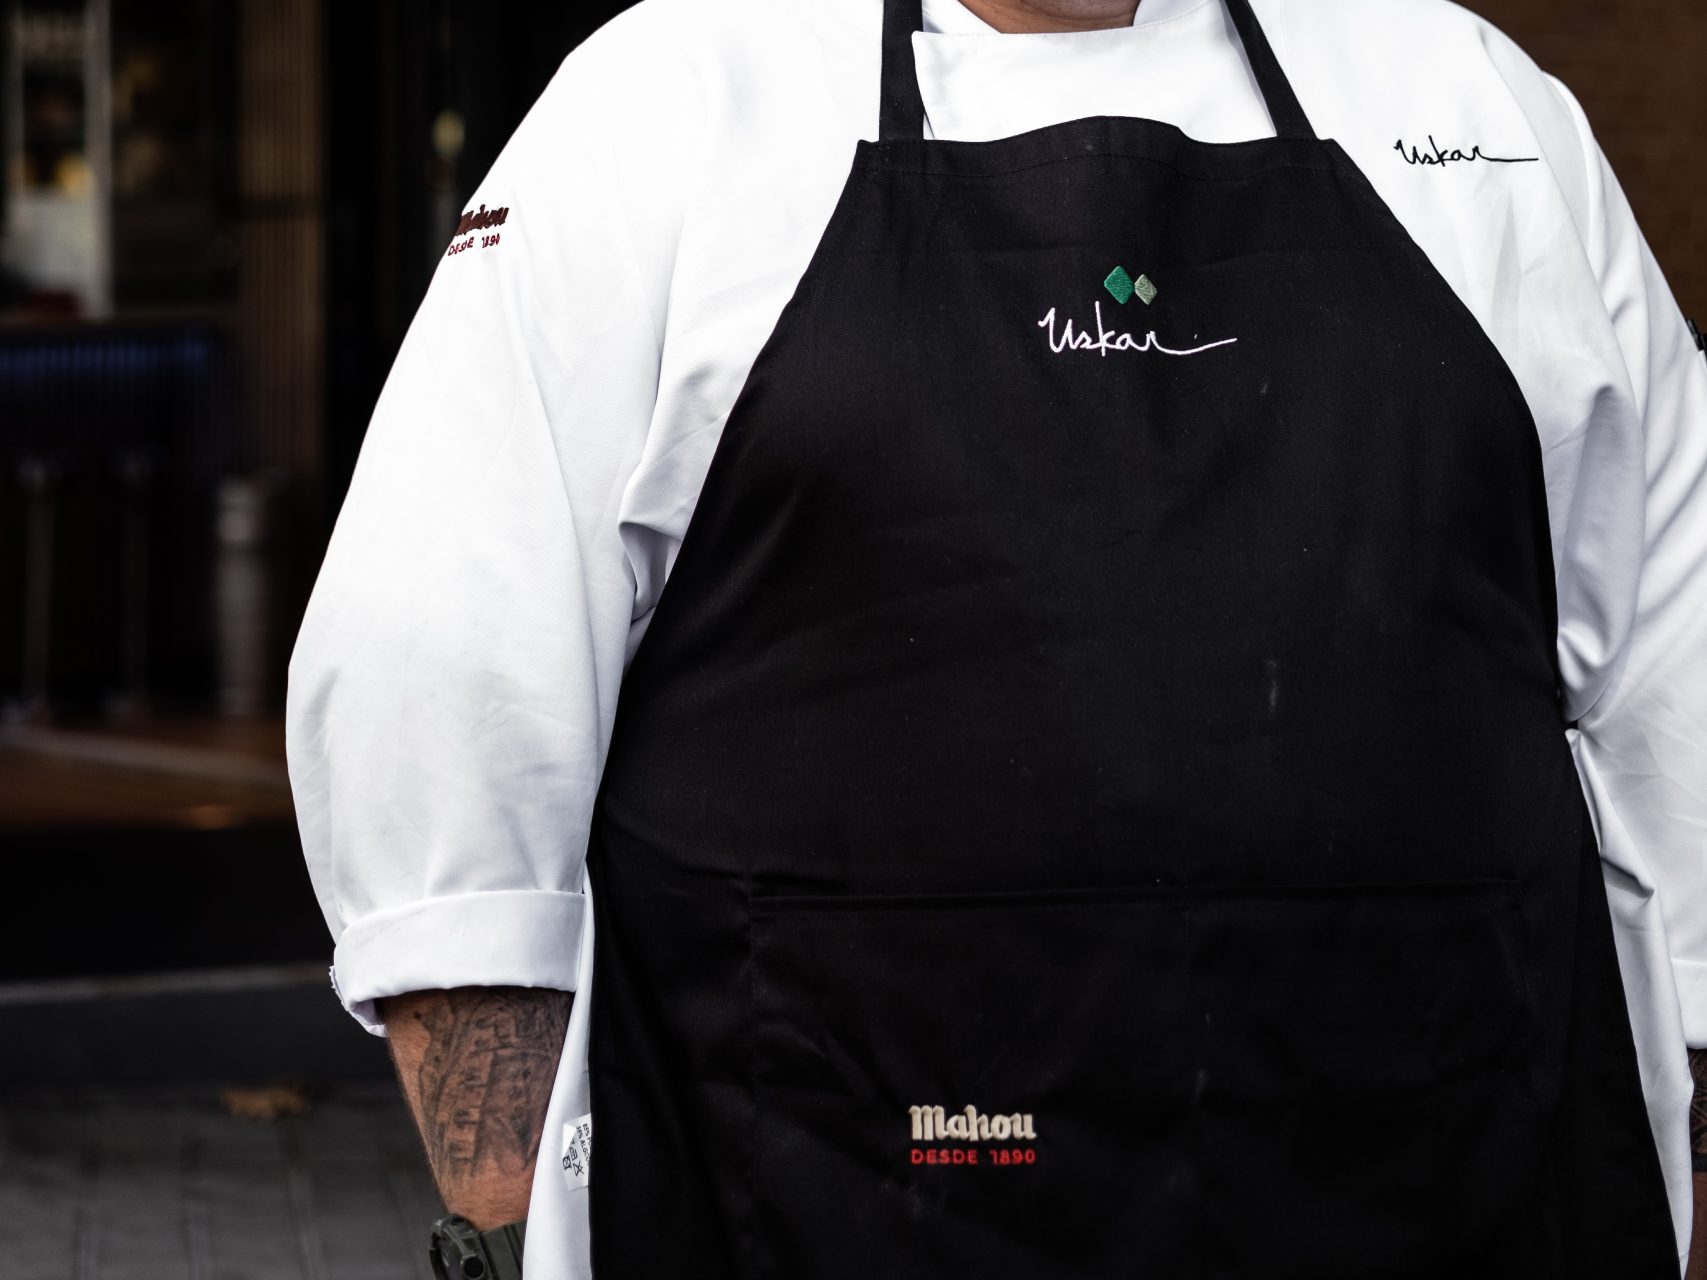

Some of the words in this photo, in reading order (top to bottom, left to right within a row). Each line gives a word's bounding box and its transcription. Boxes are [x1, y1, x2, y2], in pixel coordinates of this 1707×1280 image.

[1037, 300, 1238, 357] Uskar
[908, 1104, 1037, 1141] Mahou
[911, 1148, 977, 1164] DESDE
[990, 1149, 1035, 1165] 1890
